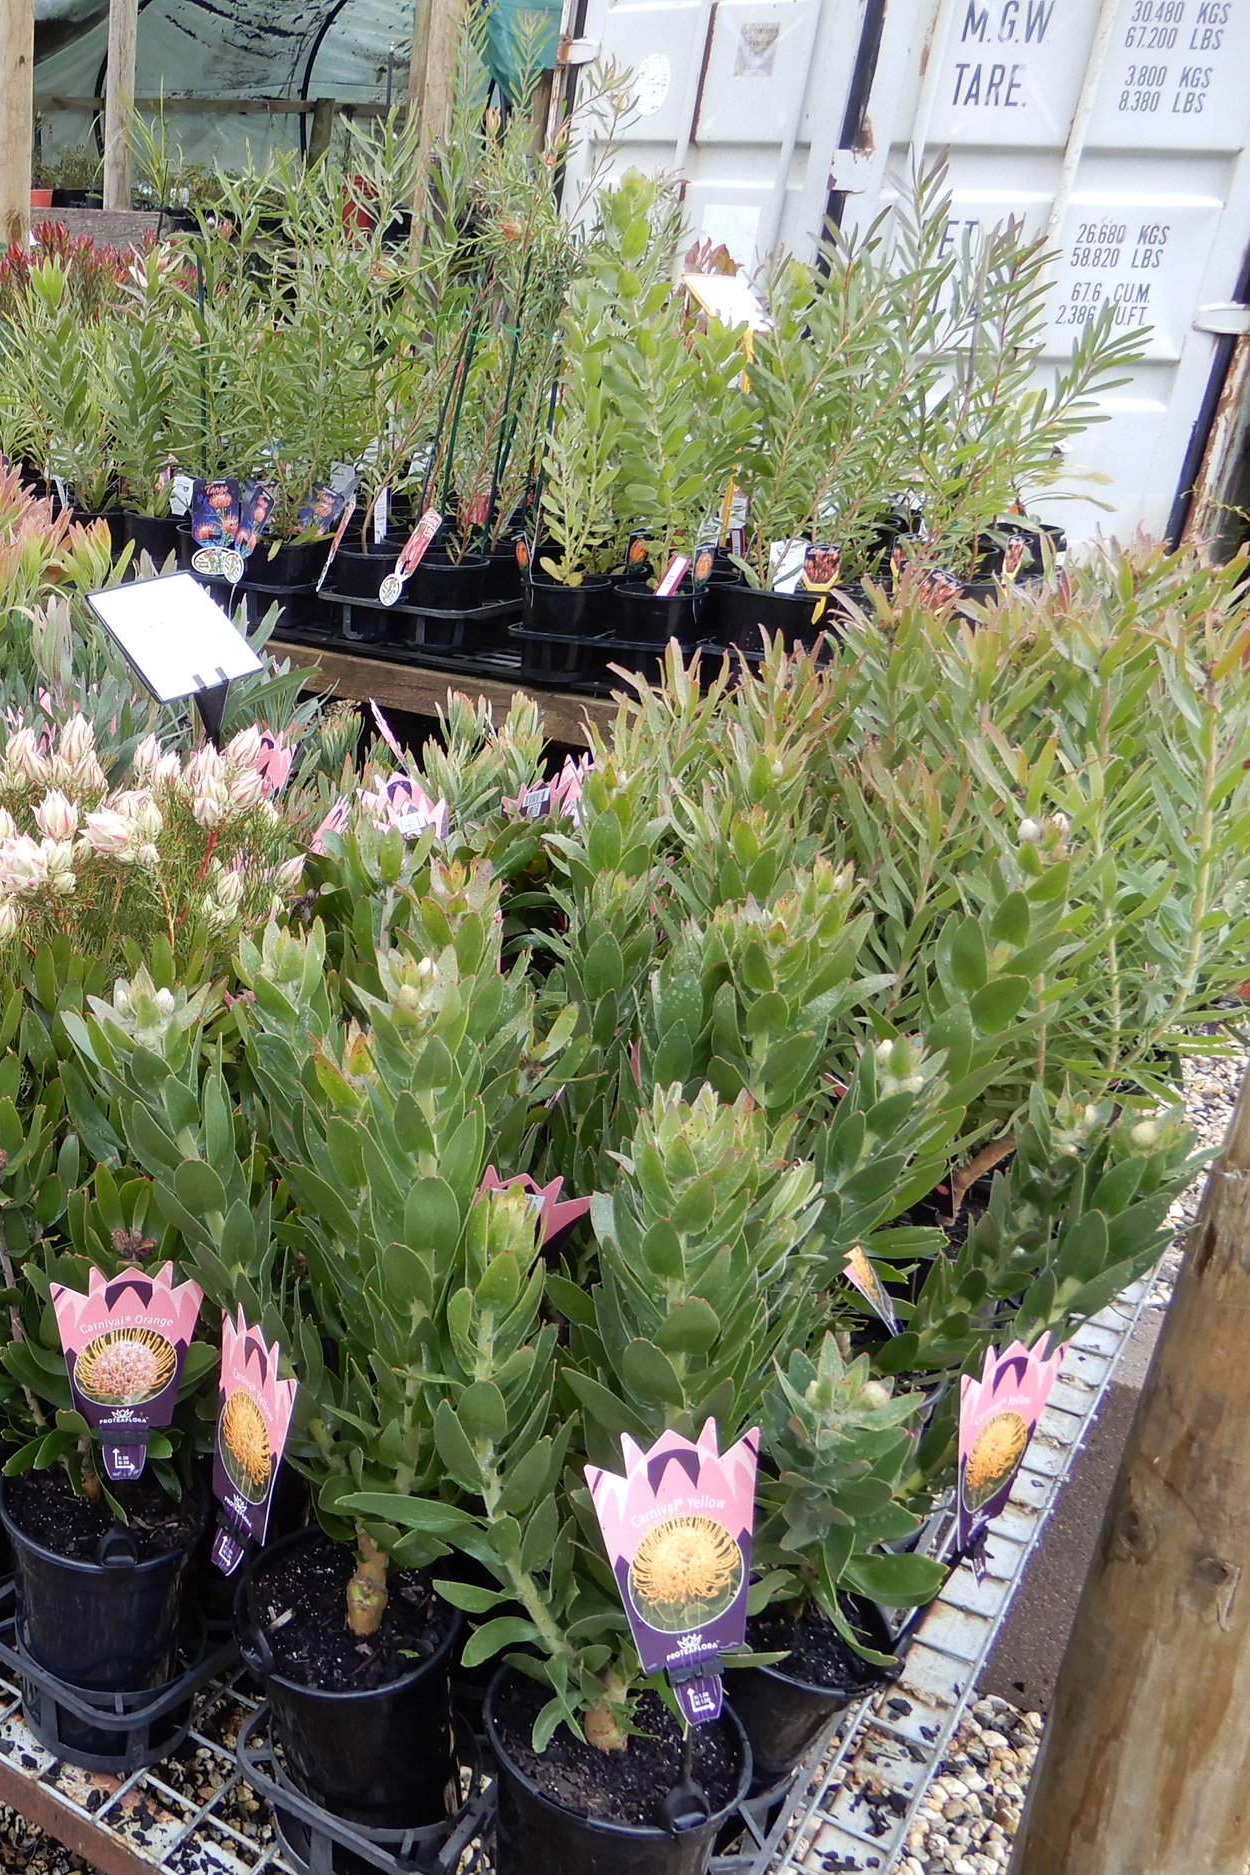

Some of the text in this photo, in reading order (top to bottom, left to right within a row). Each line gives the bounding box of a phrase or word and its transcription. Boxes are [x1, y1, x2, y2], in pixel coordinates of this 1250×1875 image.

[1196, 2, 1232, 24] KGS
[1189, 28, 1224, 50] LBS
[952, 63, 1027, 107] TARE.
[1178, 66, 1213, 88] KGS
[1172, 92, 1206, 113] LBS
[1137, 225, 1171, 245] KGS
[1131, 249, 1164, 268] LBS
[134, 1315, 173, 1327] Orange
[686, 1495, 726, 1509] Yellow
[666, 1641, 718, 1661] PROTEAFLORA
